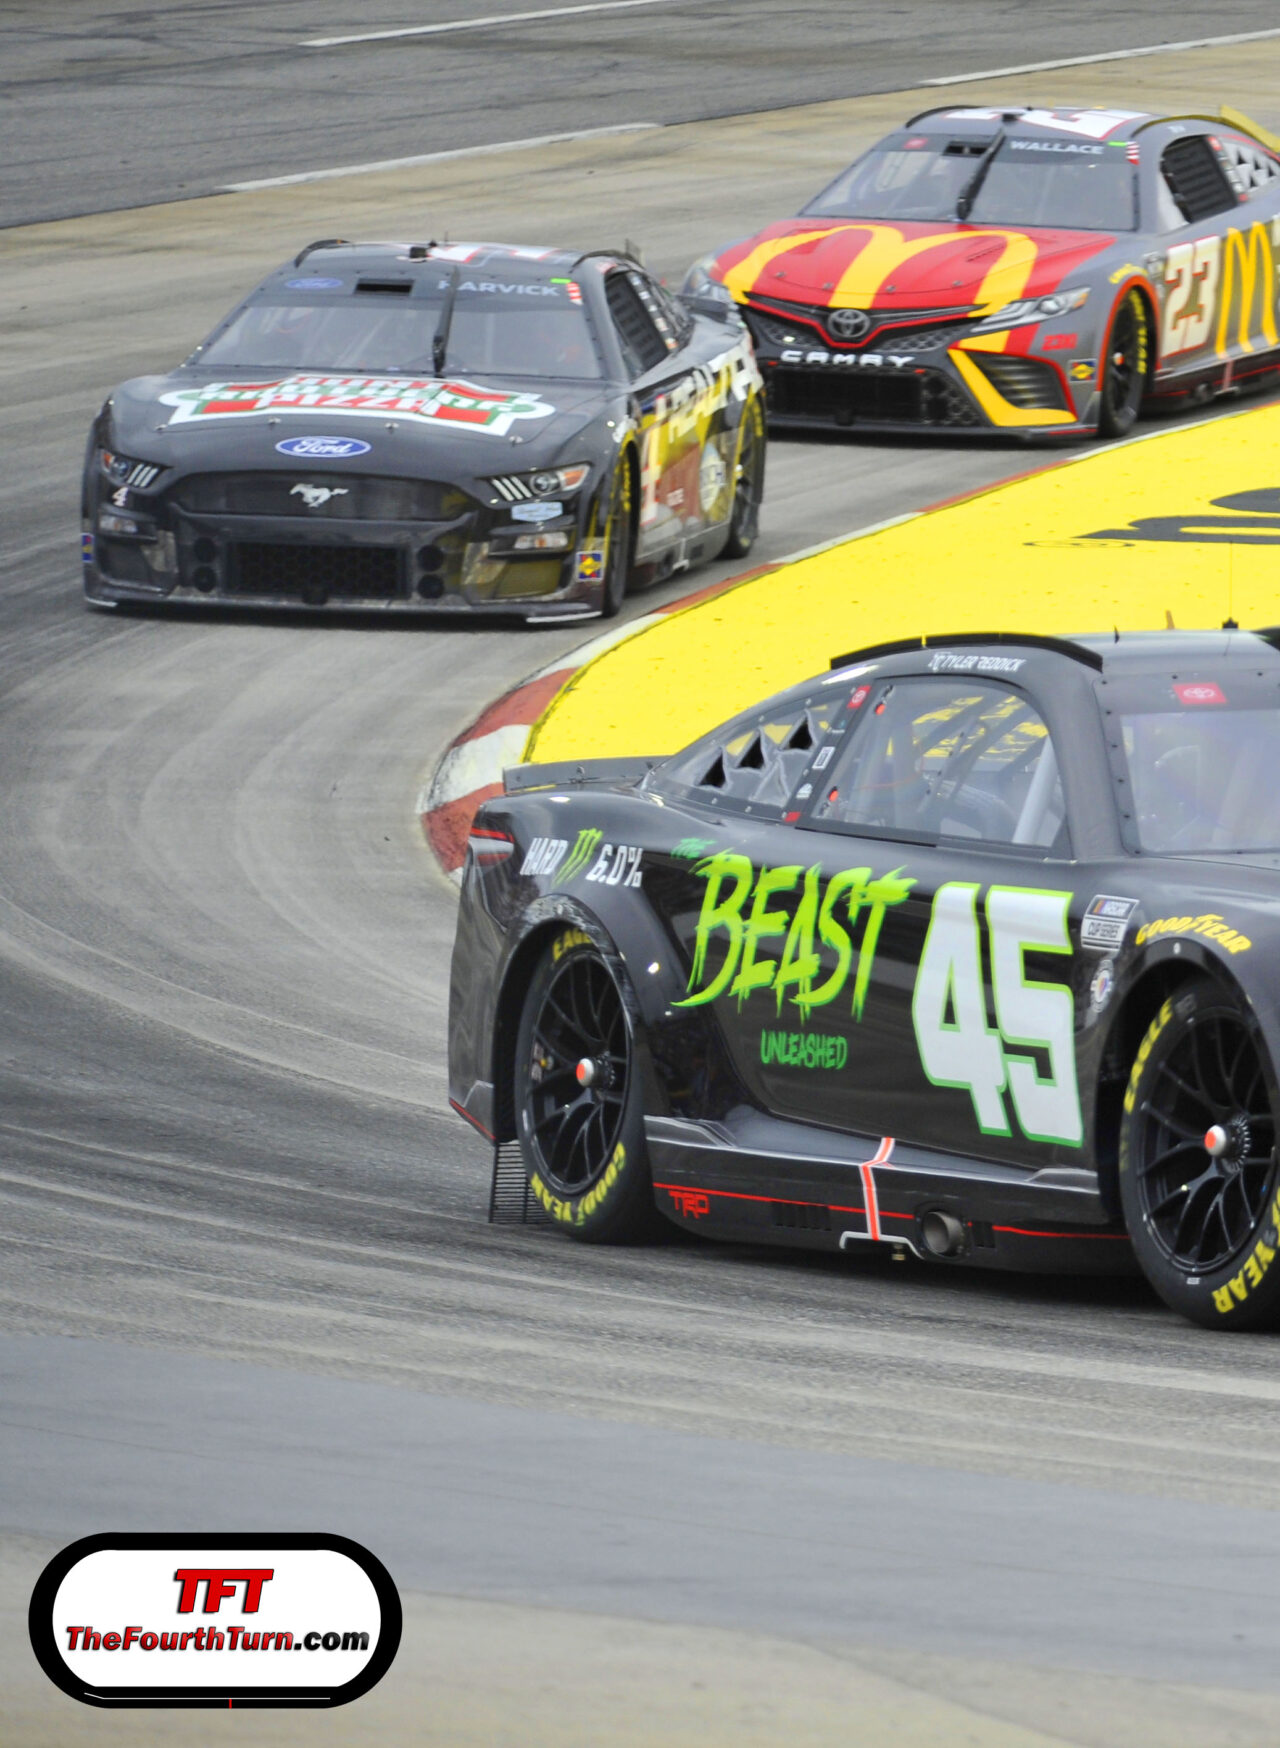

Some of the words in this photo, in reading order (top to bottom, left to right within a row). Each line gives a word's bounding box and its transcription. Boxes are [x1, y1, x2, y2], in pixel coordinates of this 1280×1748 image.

[1010, 140, 1104, 154] WALLACE
[1161, 234, 1221, 359] 23
[780, 349, 916, 368] CAMRY
[293, 438, 353, 454] Ford
[520, 838, 568, 876] HARD
[673, 848, 918, 1024] BEAST
[912, 881, 1083, 1147] 45
[761, 1030, 848, 1069] UNLEASHED
[669, 1190, 710, 1218] TRD
